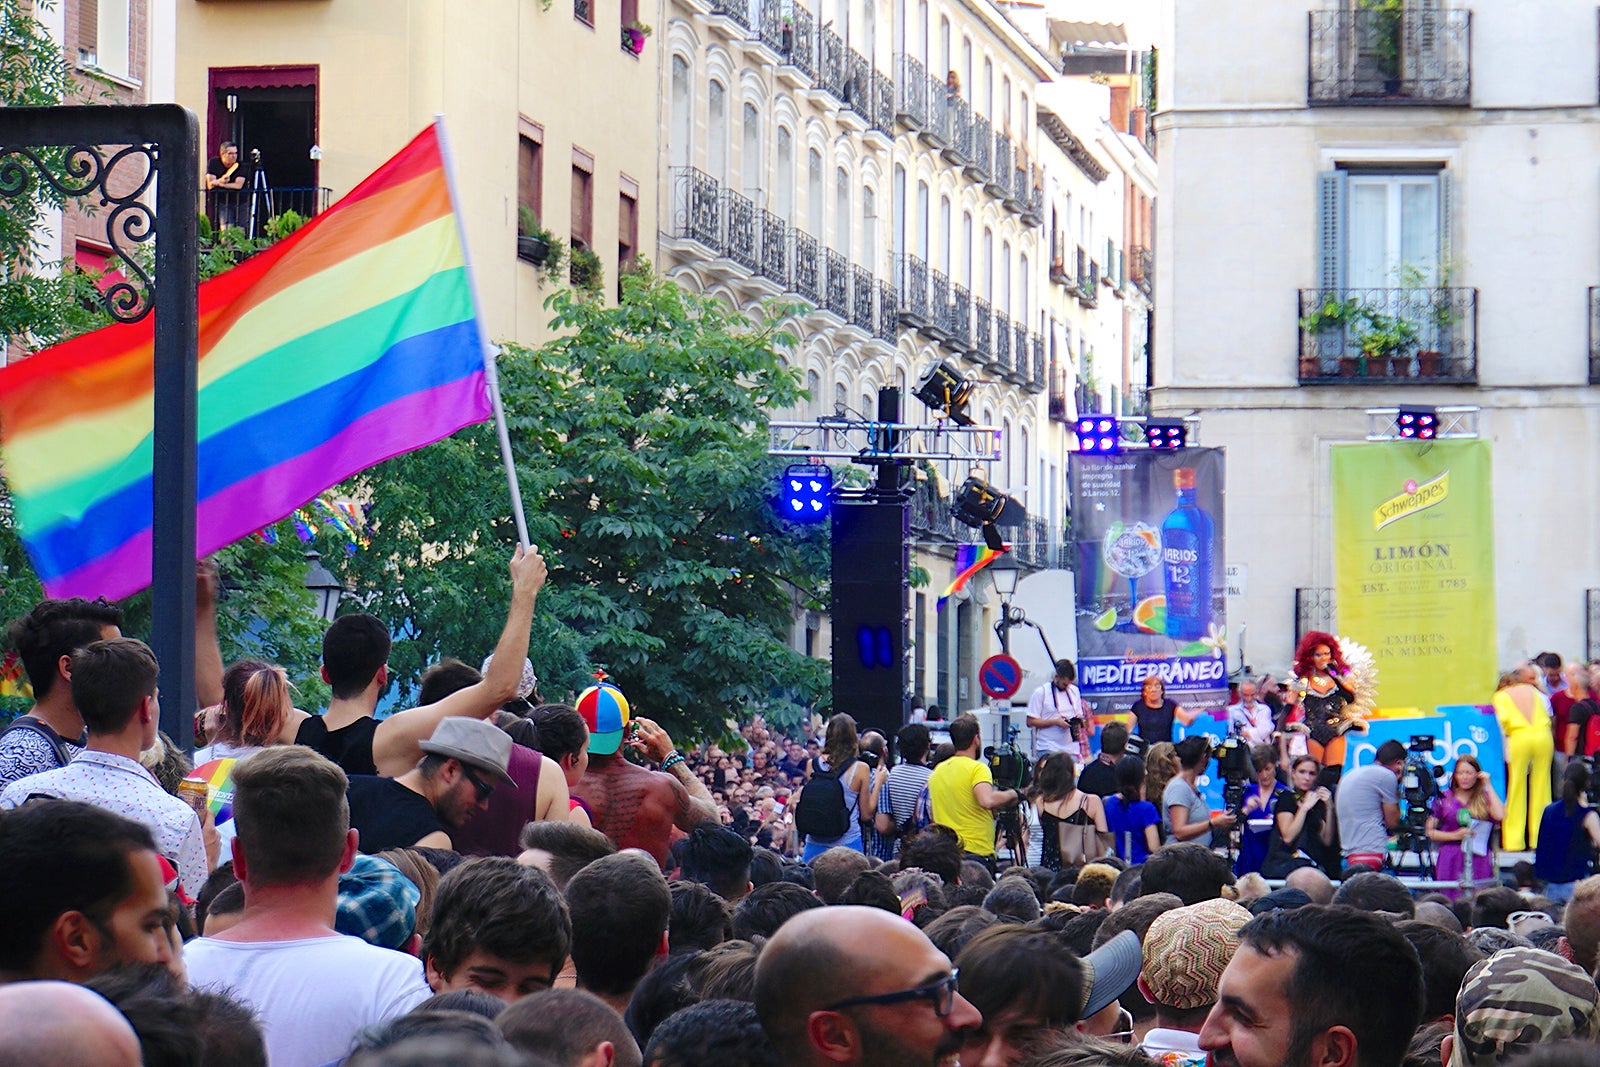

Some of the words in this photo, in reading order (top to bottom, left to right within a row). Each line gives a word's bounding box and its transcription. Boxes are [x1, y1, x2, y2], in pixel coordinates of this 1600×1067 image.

[1104, 463, 1113, 471] de
[1114, 462, 1137, 471] azahar
[1082, 481, 1091, 489] de
[1088, 489, 1110, 497] Larios
[1379, 481, 1445, 520] Schweppes
[1164, 548, 1198, 564] LARIOS
[1375, 541, 1452, 560] LIMÓN
[1369, 560, 1457, 574] ORIGINAL
[1169, 565, 1192, 585] 12
[1361, 583, 1390, 593] EST.
[1083, 657, 1224, 685] MEDITERRÁNEO
